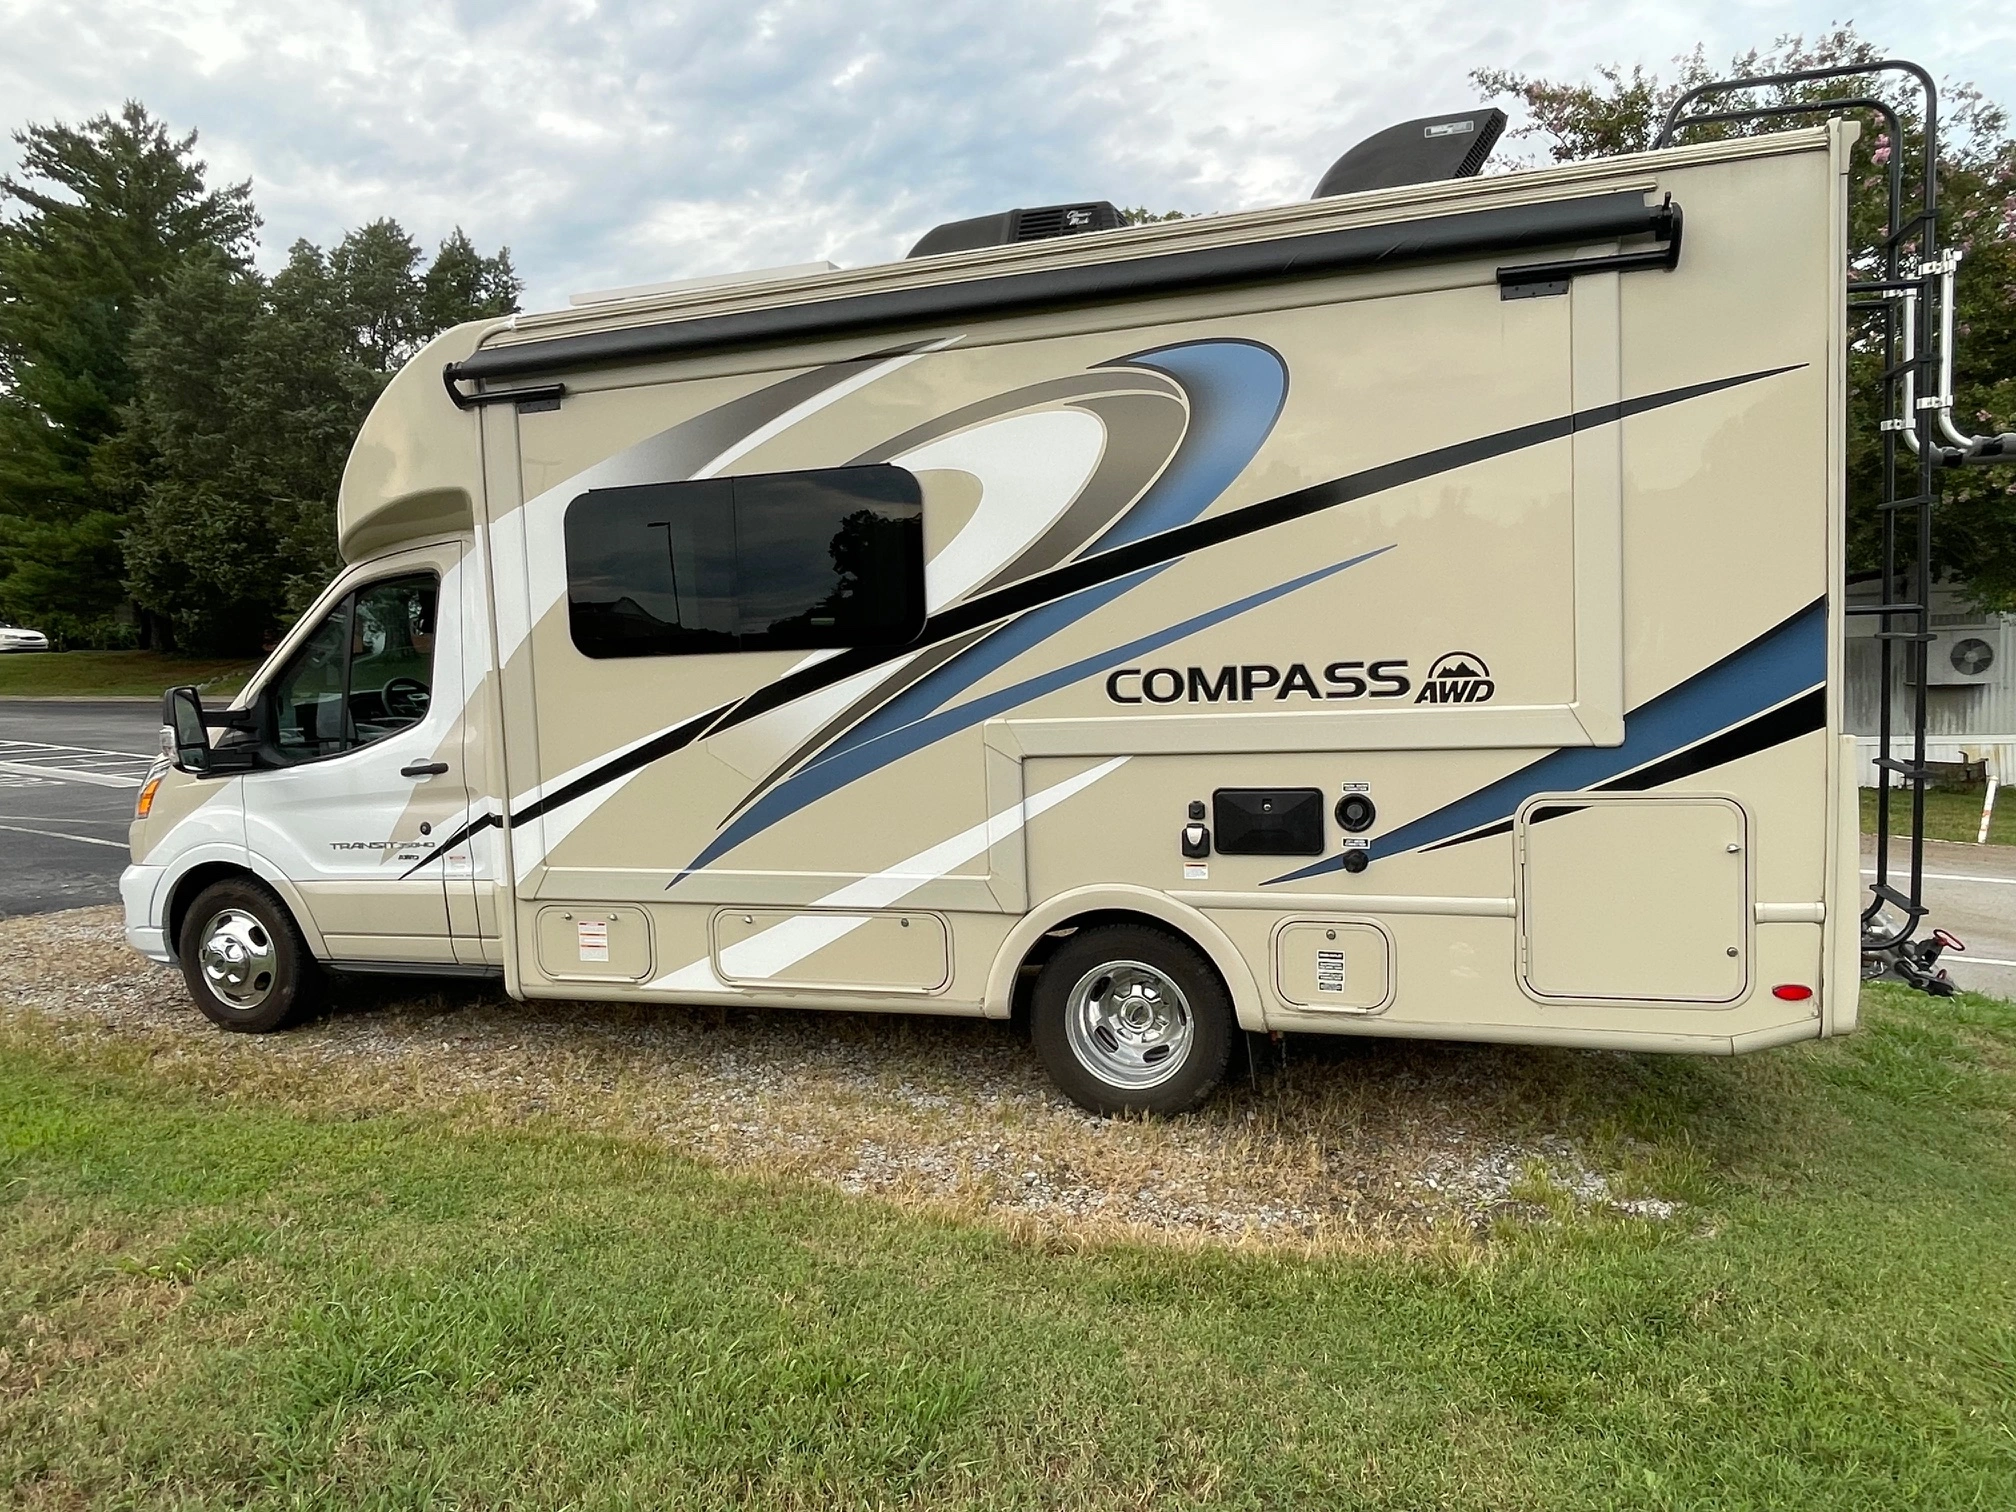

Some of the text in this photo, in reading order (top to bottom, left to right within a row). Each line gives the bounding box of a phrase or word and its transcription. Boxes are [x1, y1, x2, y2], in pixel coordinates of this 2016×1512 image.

[1106, 660, 1495, 704] COMPASS AWD
[329, 842, 397, 850] TRANSIT
